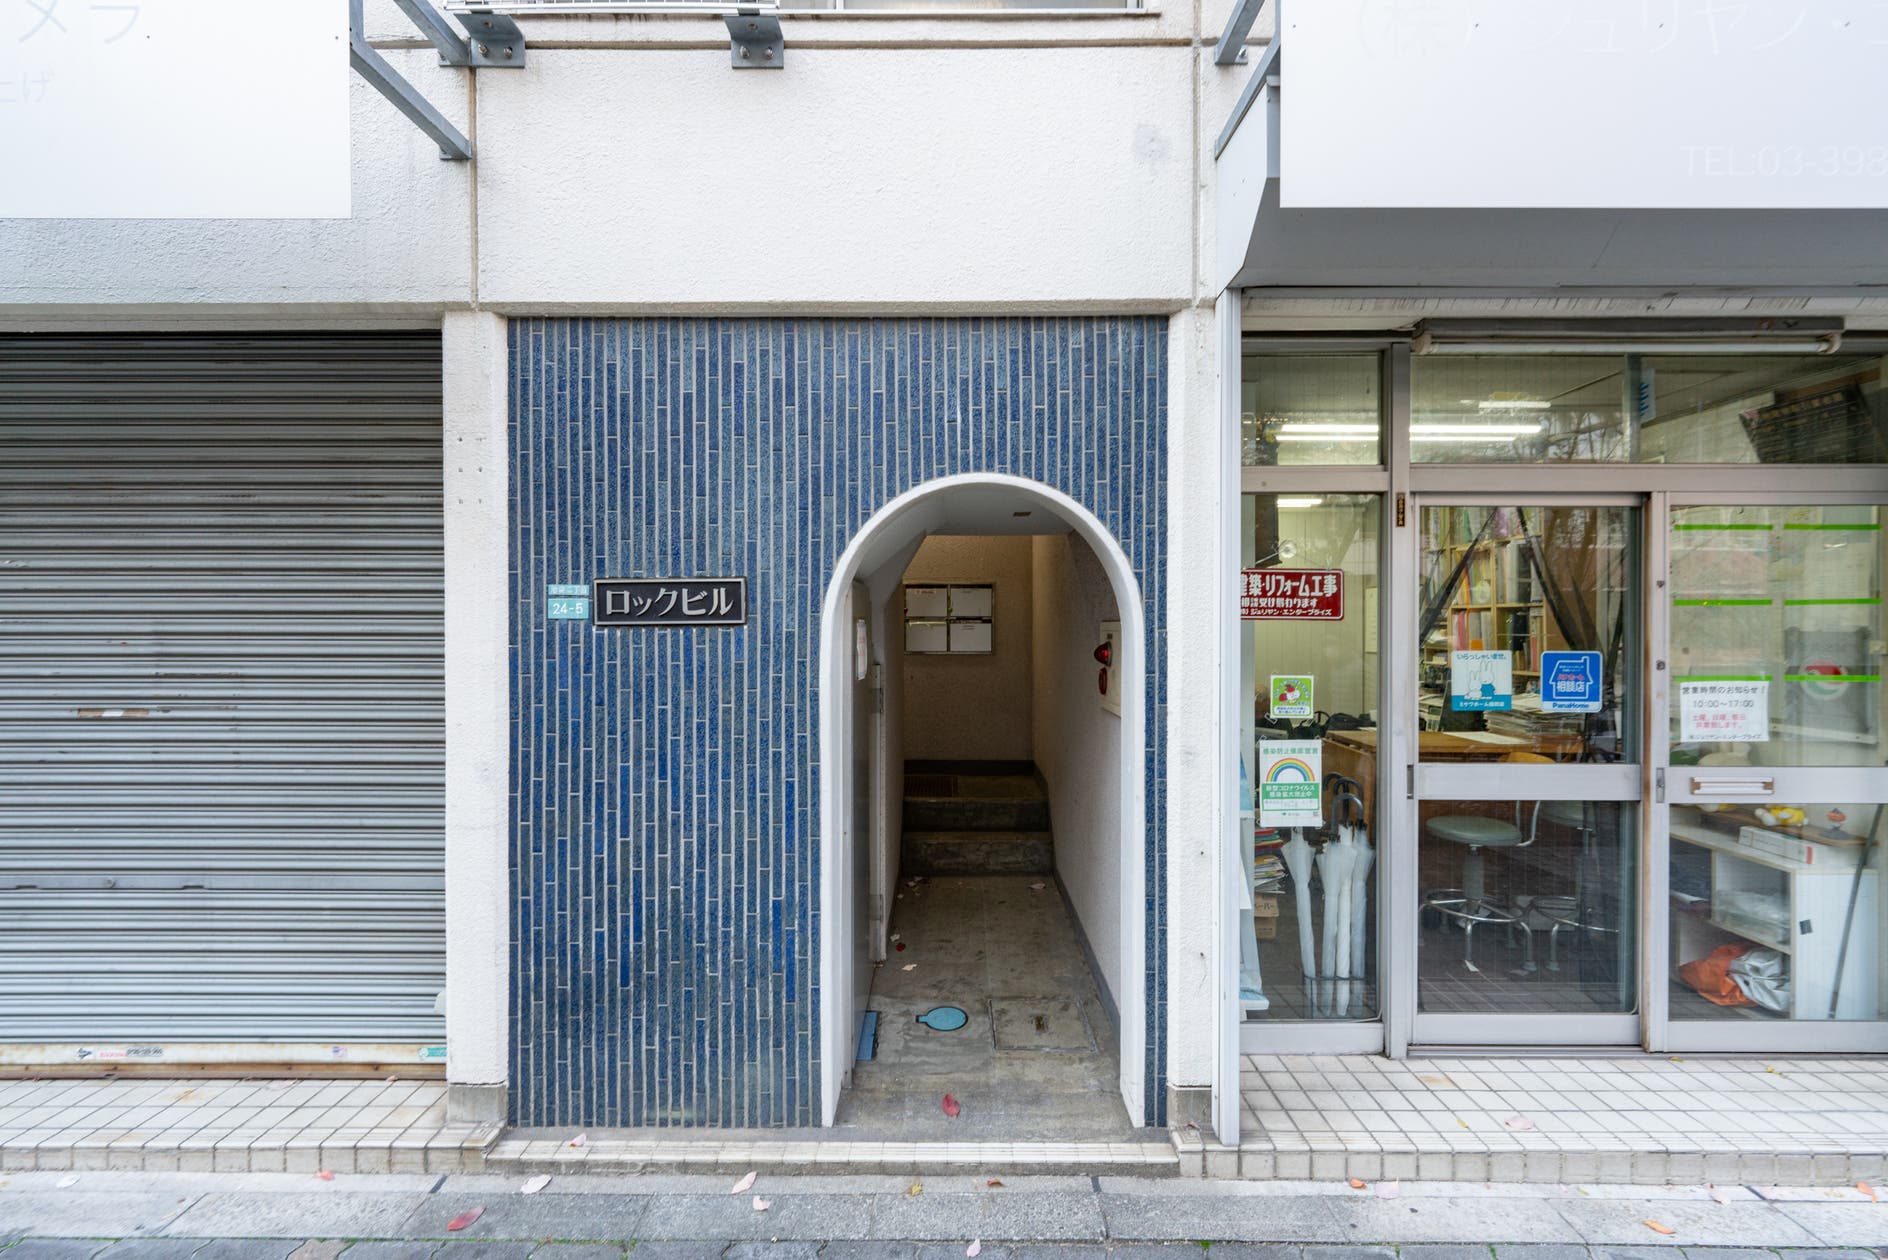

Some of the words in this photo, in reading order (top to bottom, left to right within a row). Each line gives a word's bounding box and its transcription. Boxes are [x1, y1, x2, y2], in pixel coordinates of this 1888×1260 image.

[606, 587, 734, 616] ロックビル
[552, 602, 584, 615] 24-5
[1556, 681, 1585, 692] 相談店
